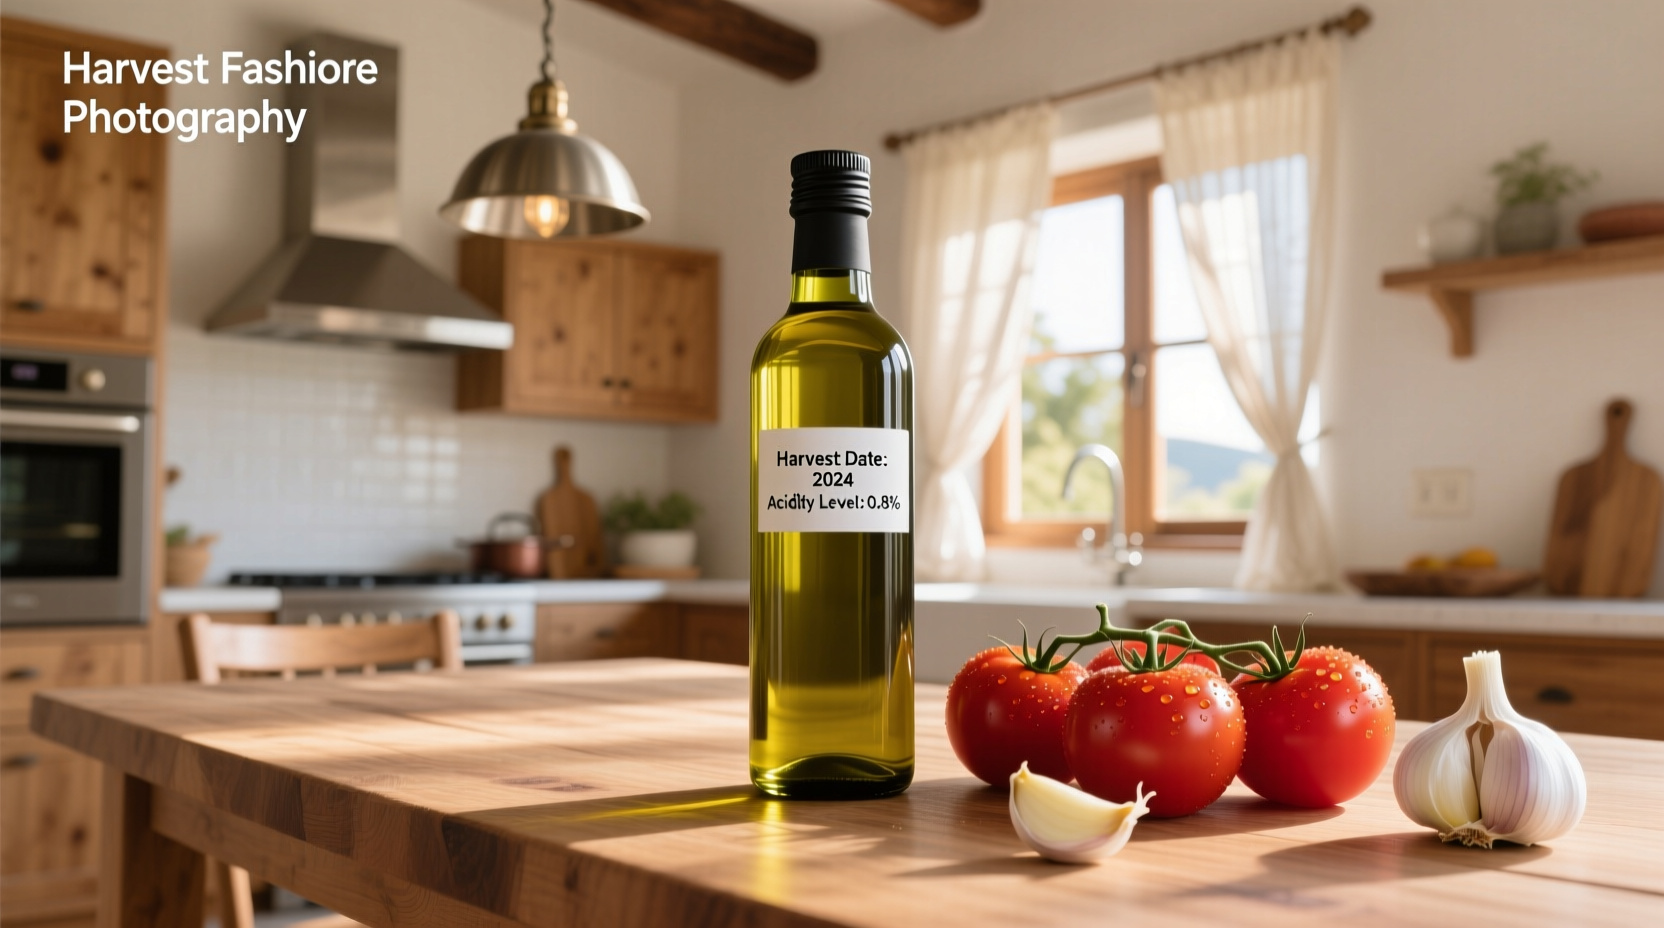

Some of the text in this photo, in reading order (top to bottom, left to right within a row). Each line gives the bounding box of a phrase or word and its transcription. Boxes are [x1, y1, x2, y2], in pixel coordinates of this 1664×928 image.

[776, 450, 888, 467] Harvest Date:
[812, 471, 855, 488] 2024
[818, 493, 865, 511] Level:
[866, 494, 902, 511] 0.8%
